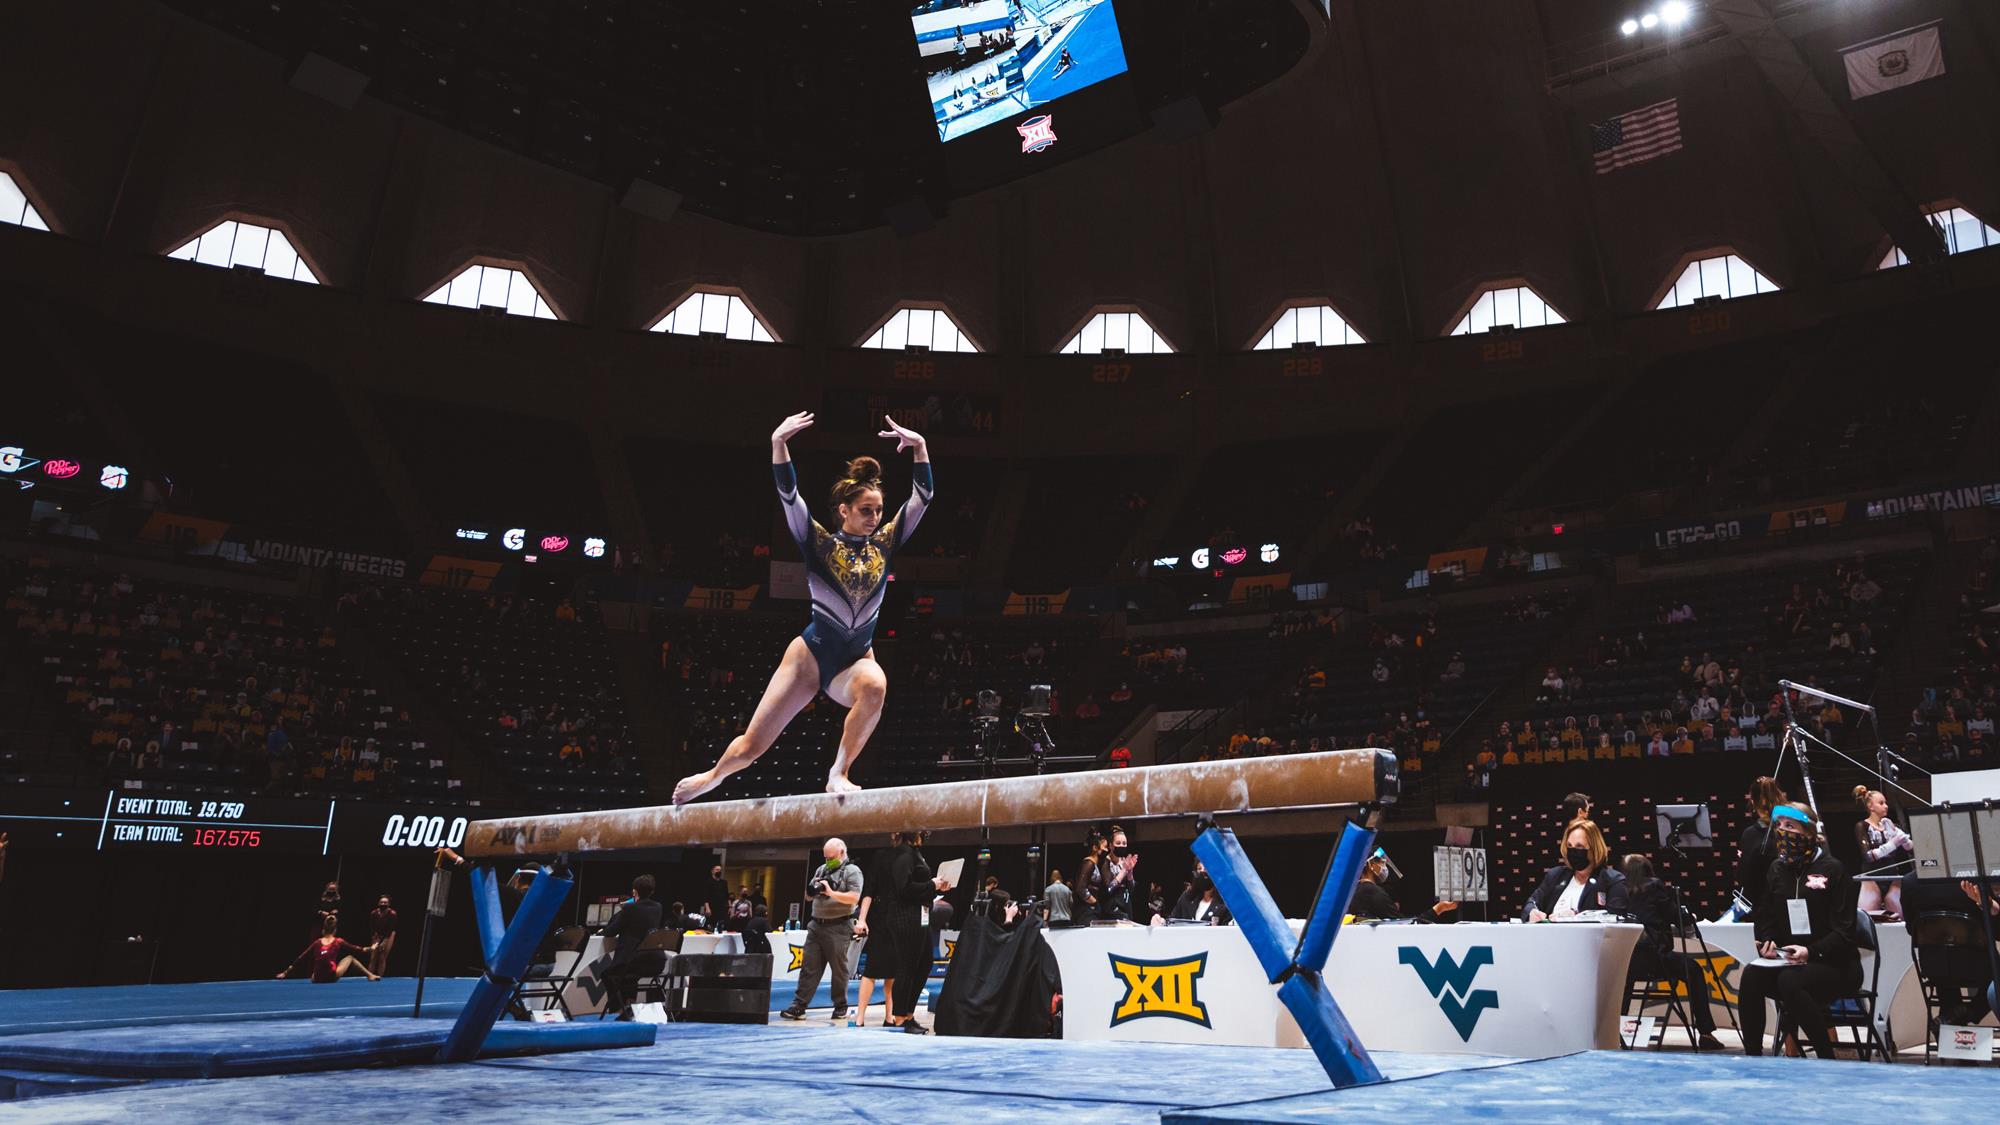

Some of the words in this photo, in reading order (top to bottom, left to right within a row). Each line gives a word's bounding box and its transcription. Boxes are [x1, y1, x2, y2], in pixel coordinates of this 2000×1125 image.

[1020, 120, 1054, 147] XII
[1093, 363, 1133, 384] 227
[0, 446, 23, 472] G
[48, 460, 76, 476] Pepper
[58, 460, 70, 468] Dr
[1715, 521, 1740, 543] GO
[253, 540, 407, 578] MOUNTAINEERS
[1191, 548, 1209, 569] G
[117, 798, 154, 814] EVENT
[156, 799, 192, 816] TOTAL:
[197, 801, 244, 819] 19.750
[113, 825, 144, 841] TEAM
[146, 826, 183, 842] TOTAL:
[193, 829, 261, 847] 167.575
[382, 814, 468, 848] 0:00.0
[1113, 958, 1205, 1021] XII
[1398, 946, 1499, 1042] WV
